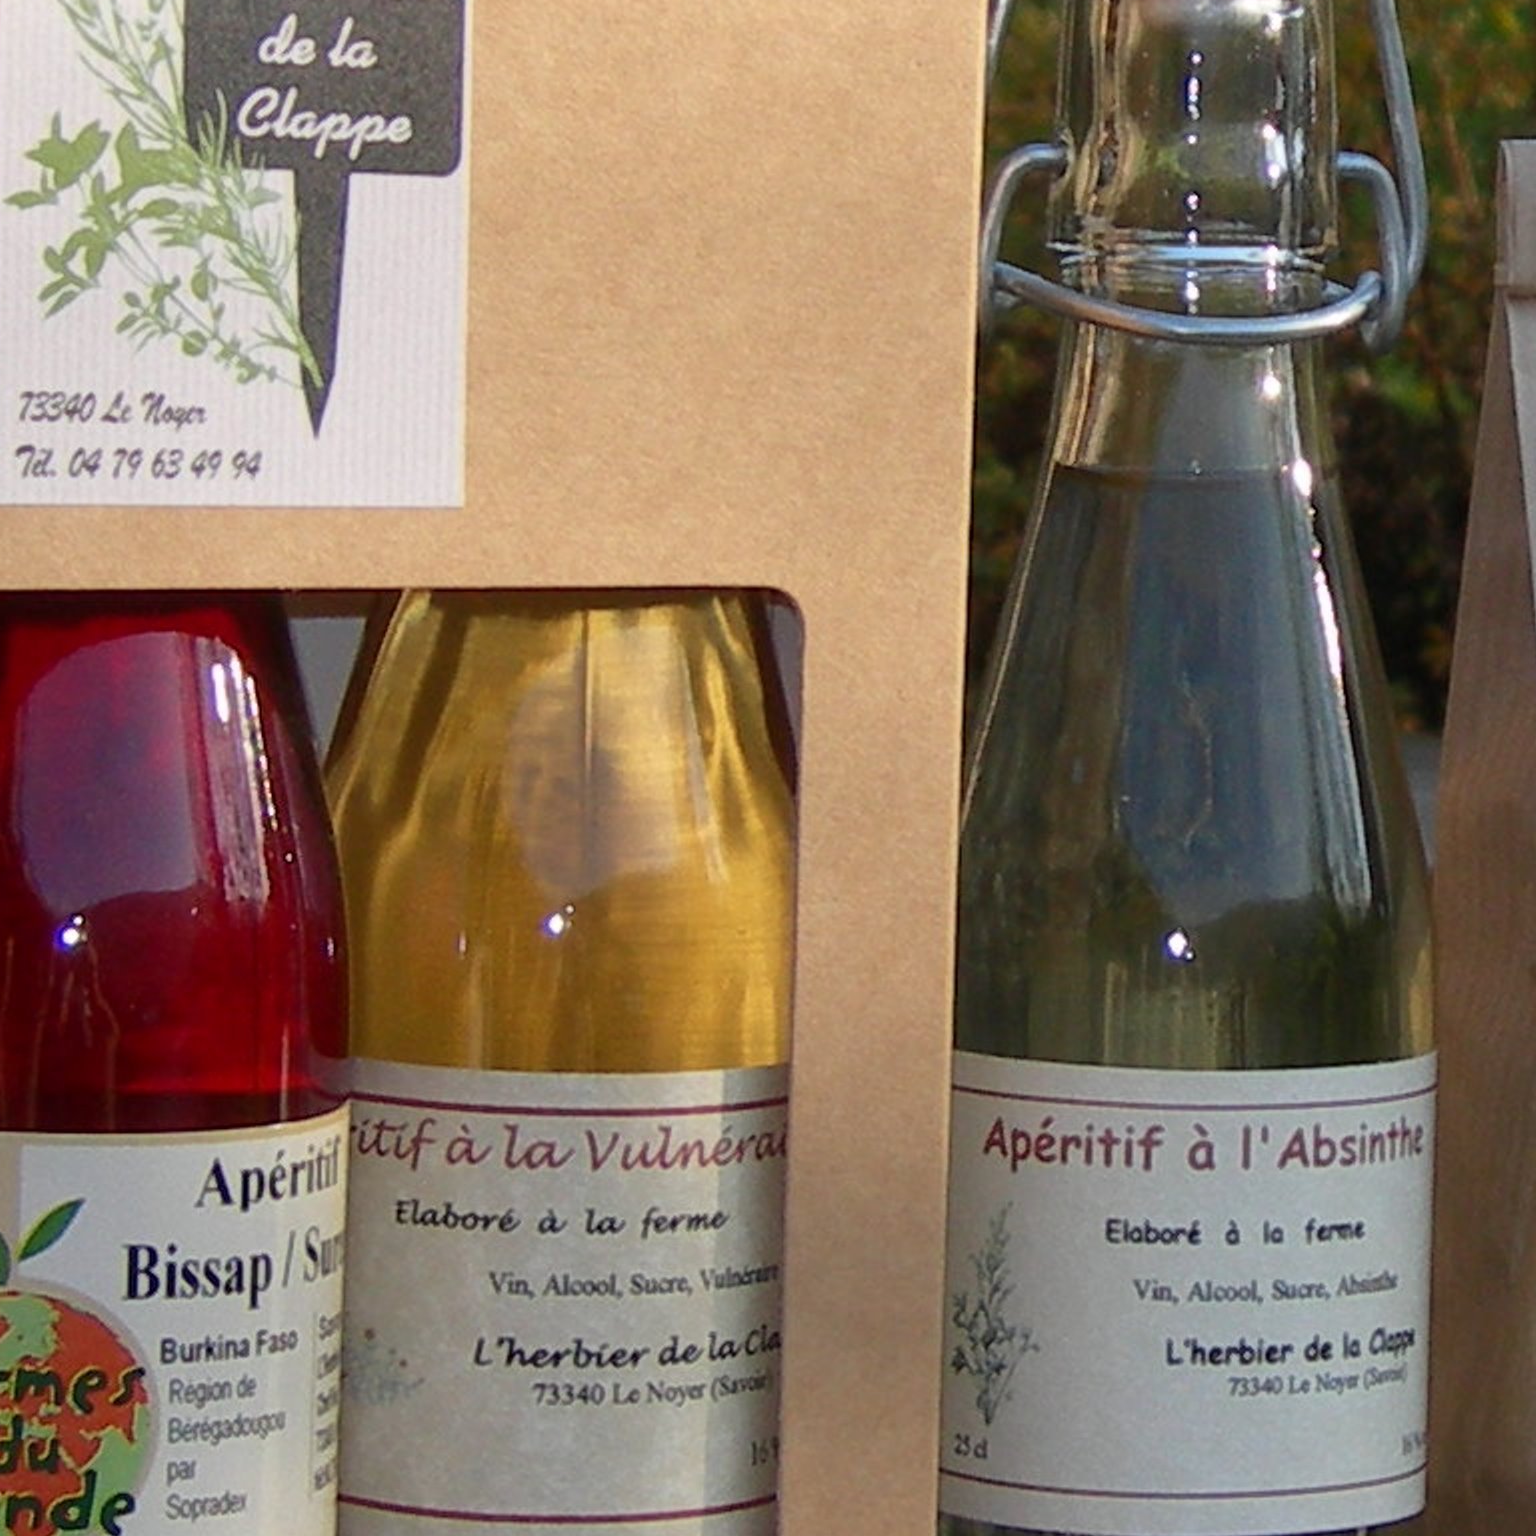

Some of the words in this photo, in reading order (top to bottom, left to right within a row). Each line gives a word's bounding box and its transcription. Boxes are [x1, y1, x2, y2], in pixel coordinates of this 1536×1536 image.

[258, 18, 317, 68] de
[326, 16, 377, 69] la
[236, 88, 412, 159] Clappe
[19, 390, 95, 423] 73340
[100, 393, 136, 425] Le
[141, 393, 208, 433] Noyer
[67, 448, 103, 478] 04
[112, 448, 143, 478] 79
[150, 448, 182, 478] 63
[189, 448, 225, 478] 49
[231, 448, 262, 480] 94
[446, 1124, 488, 1165] à
[505, 1124, 576, 1171] la
[983, 1115, 1167, 1173] Apéritif
[1187, 1123, 1218, 1171] à
[195, 1135, 340, 1213] Apéritif
[395, 1199, 520, 1234] Elaboré
[538, 1207, 565, 1234] à
[585, 1206, 625, 1236] la
[641, 1208, 730, 1240] ferme
[1105, 1218, 1203, 1246] Elaboré
[1225, 1220, 1241, 1246] à
[1263, 1219, 1284, 1245] la
[1305, 1216, 1365, 1245] ferme
[123, 1242, 273, 1309] Bissap
[489, 1271, 536, 1299] Vin,
[542, 1272, 624, 1300] Alcool,
[630, 1272, 694, 1297] Sucre,
[1133, 1279, 1179, 1304] Vin,
[1187, 1279, 1264, 1304] Alcool,
[1271, 1279, 1331, 1300] Sucre,
[160, 1336, 251, 1365] Burkina
[255, 1328, 299, 1357] Faso
[472, 1335, 649, 1367] L'herbier
[658, 1335, 704, 1366] de
[708, 1331, 743, 1361] la
[1166, 1336, 1295, 1366] L'herbier
[1304, 1335, 1333, 1363] de
[1343, 1331, 1361, 1359] la
[168, 1378, 233, 1409] Région
[236, 1374, 257, 1400] de
[532, 1383, 604, 1407] 73340
[613, 1382, 641, 1406] Le
[647, 1380, 706, 1408] Noyer
[1227, 1376, 1284, 1397] 73340
[1288, 1375, 1312, 1395] Le
[166, 1457, 196, 1487] par
[165, 1491, 247, 1524] Sopradex
